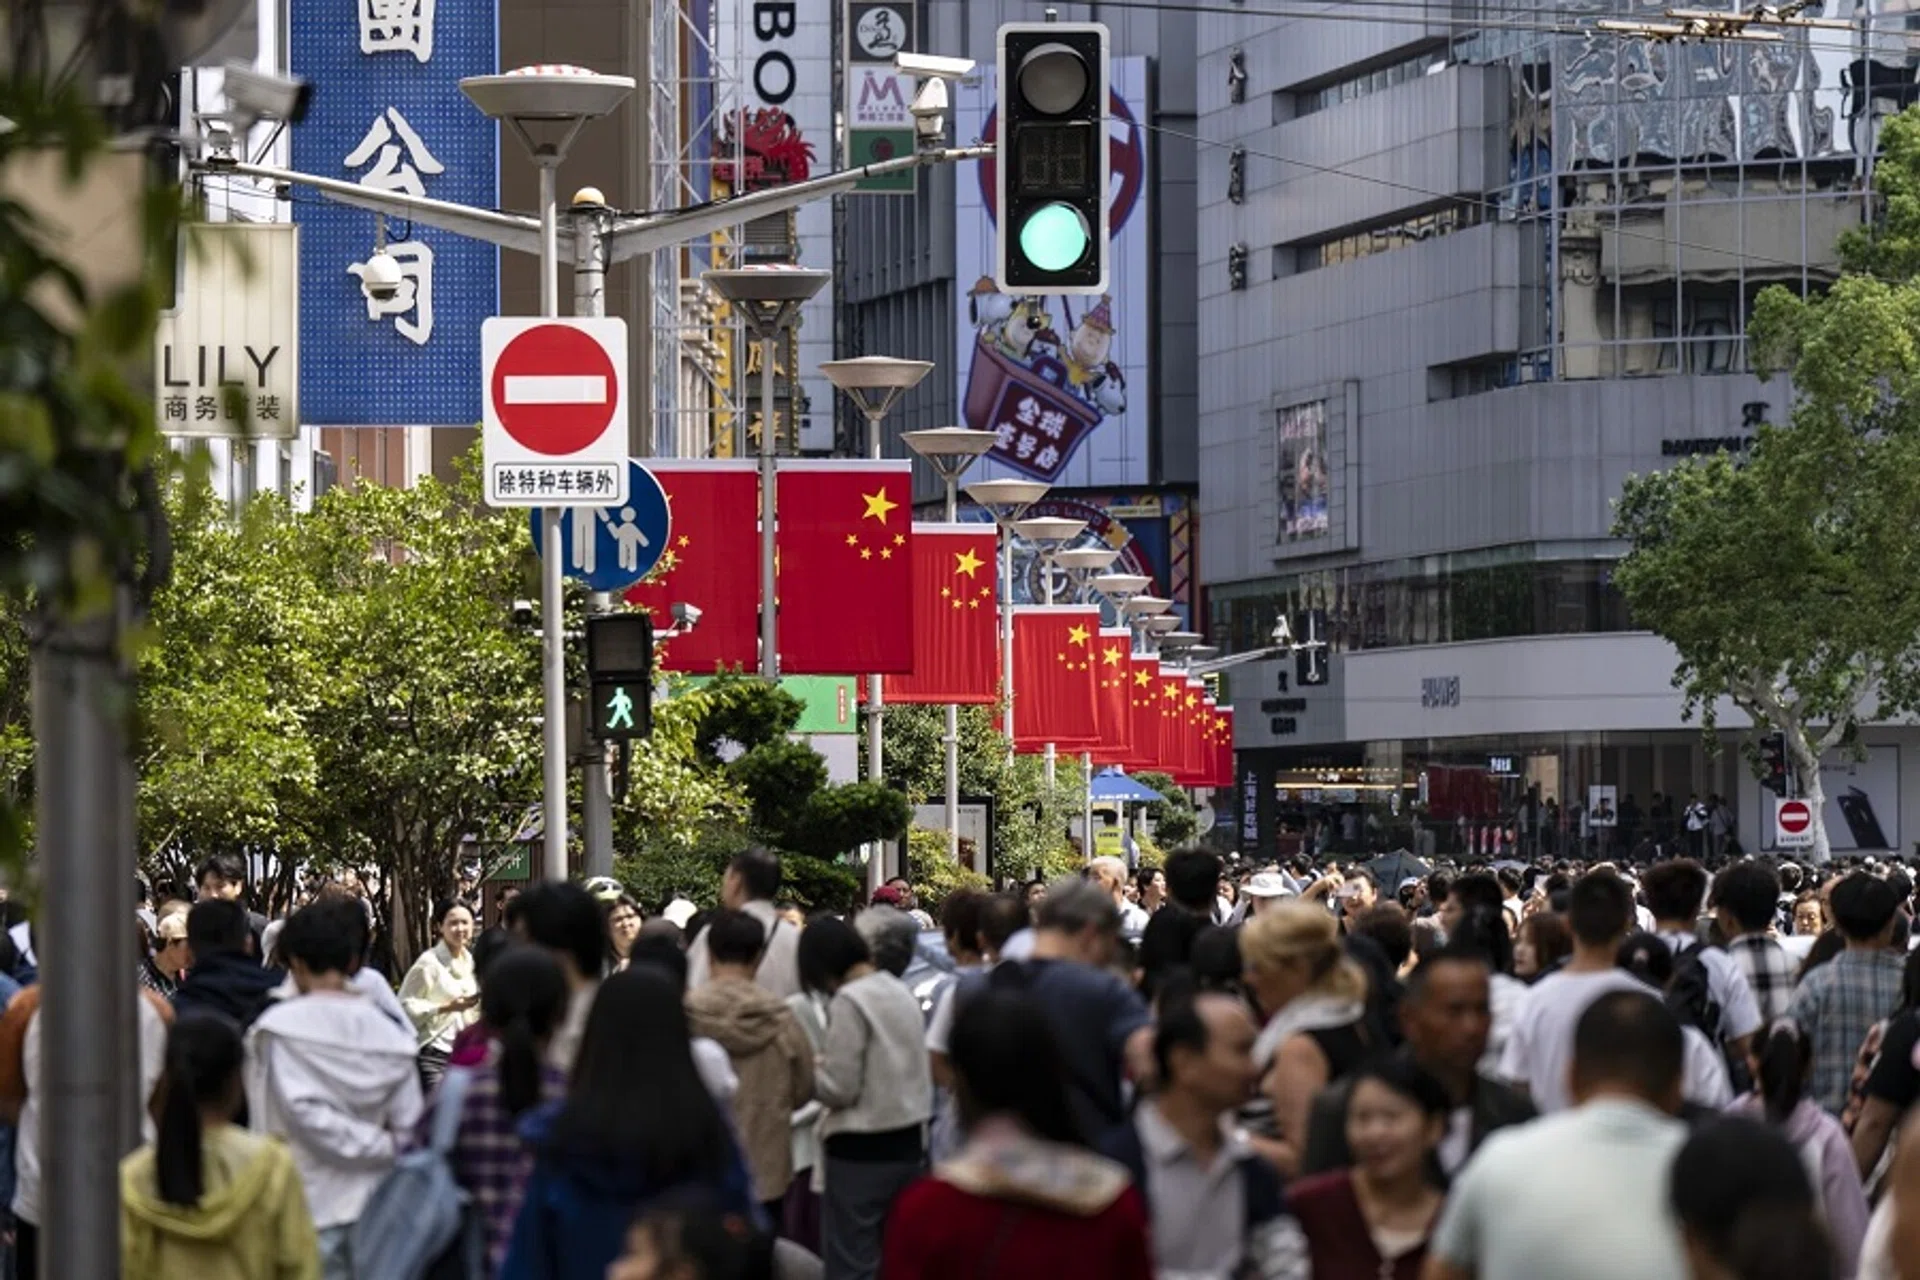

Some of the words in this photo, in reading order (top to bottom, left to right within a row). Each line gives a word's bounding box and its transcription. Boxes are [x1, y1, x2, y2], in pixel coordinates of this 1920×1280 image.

[164, 345, 281, 388] LILY
[163, 395, 281, 421] 商务装
[498, 469, 614, 494] 除特种车辆外
